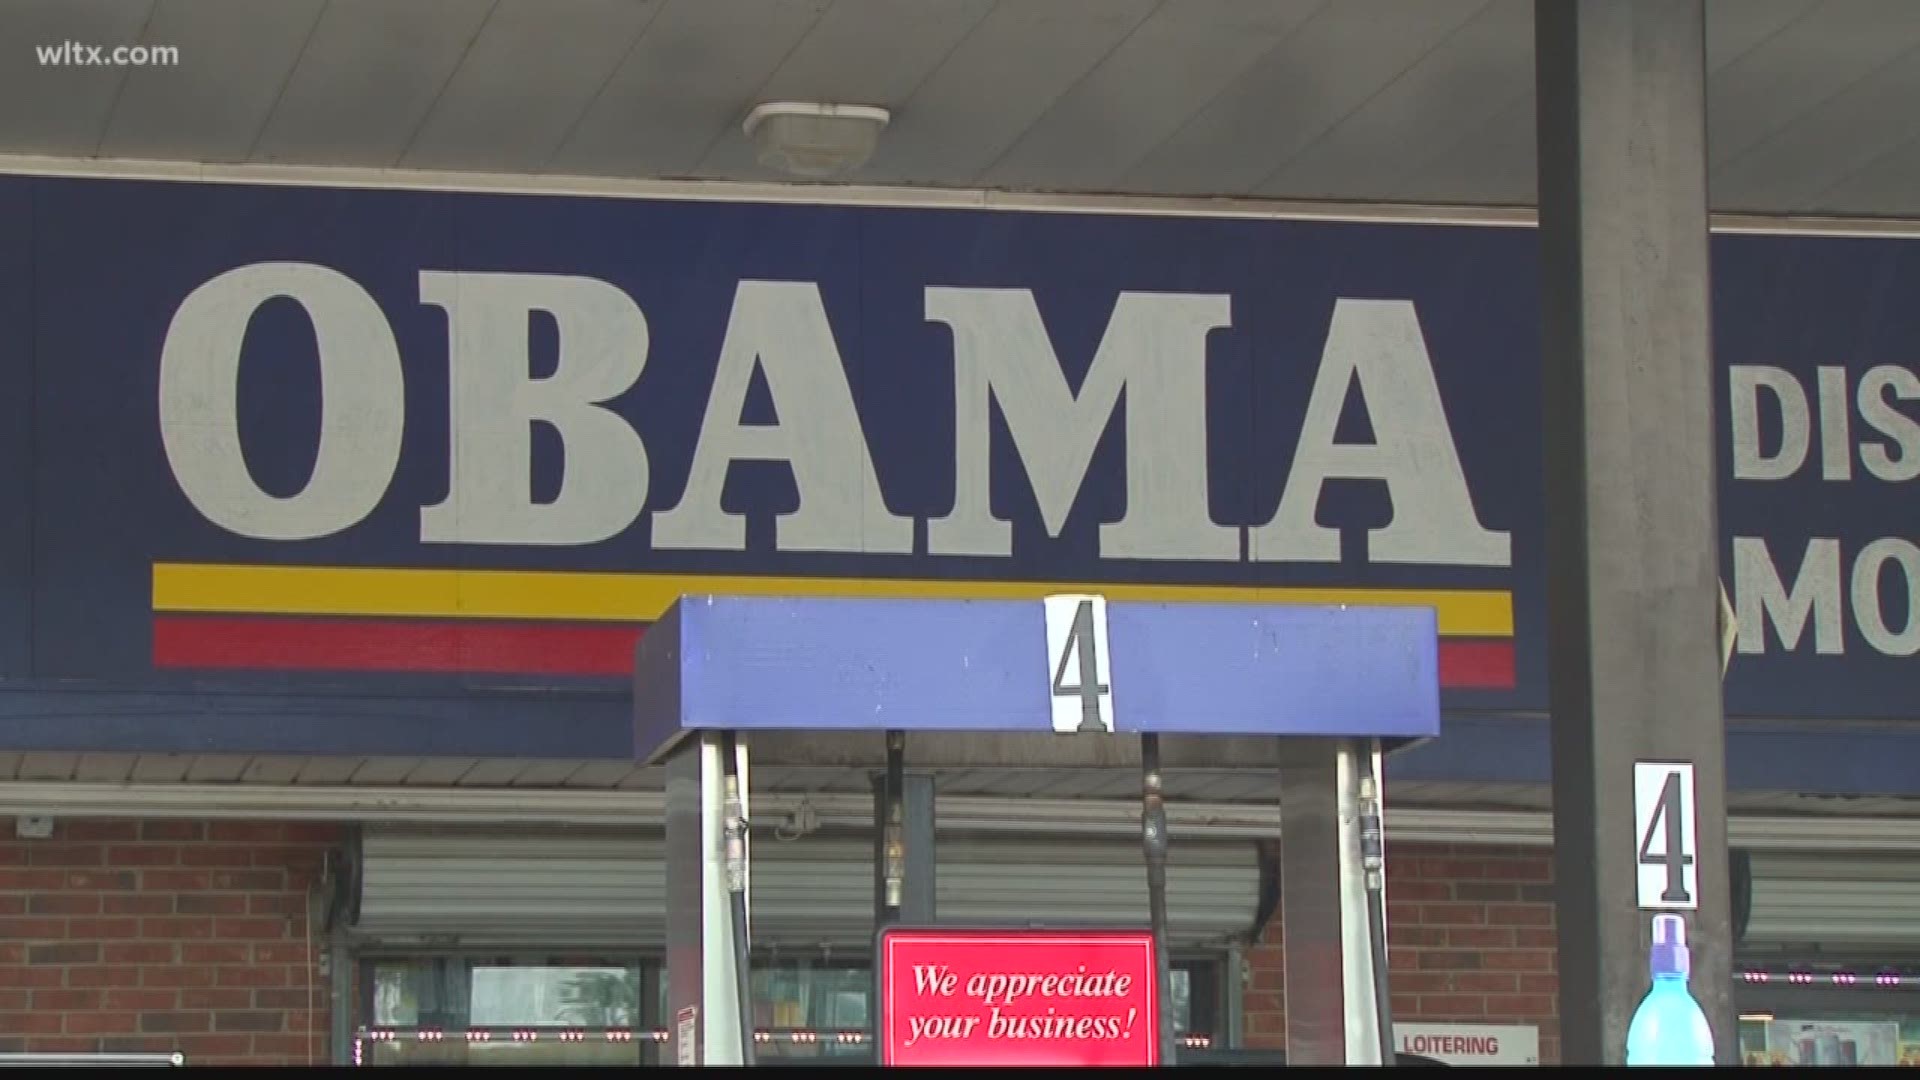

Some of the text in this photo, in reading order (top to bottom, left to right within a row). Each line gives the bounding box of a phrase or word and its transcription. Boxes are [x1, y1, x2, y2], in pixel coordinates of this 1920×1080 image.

[158, 261, 1513, 567] OBAMA
[1729, 364, 1920, 481] DIS
[1732, 535, 1920, 656] MO
[1053, 599, 1110, 732] 4
[1639, 770, 1694, 903] 4
[903, 1006, 1138, 1047] your business!
[911, 964, 1132, 1005] We appreciate
[1403, 1034, 1499, 1056] LOITERING
